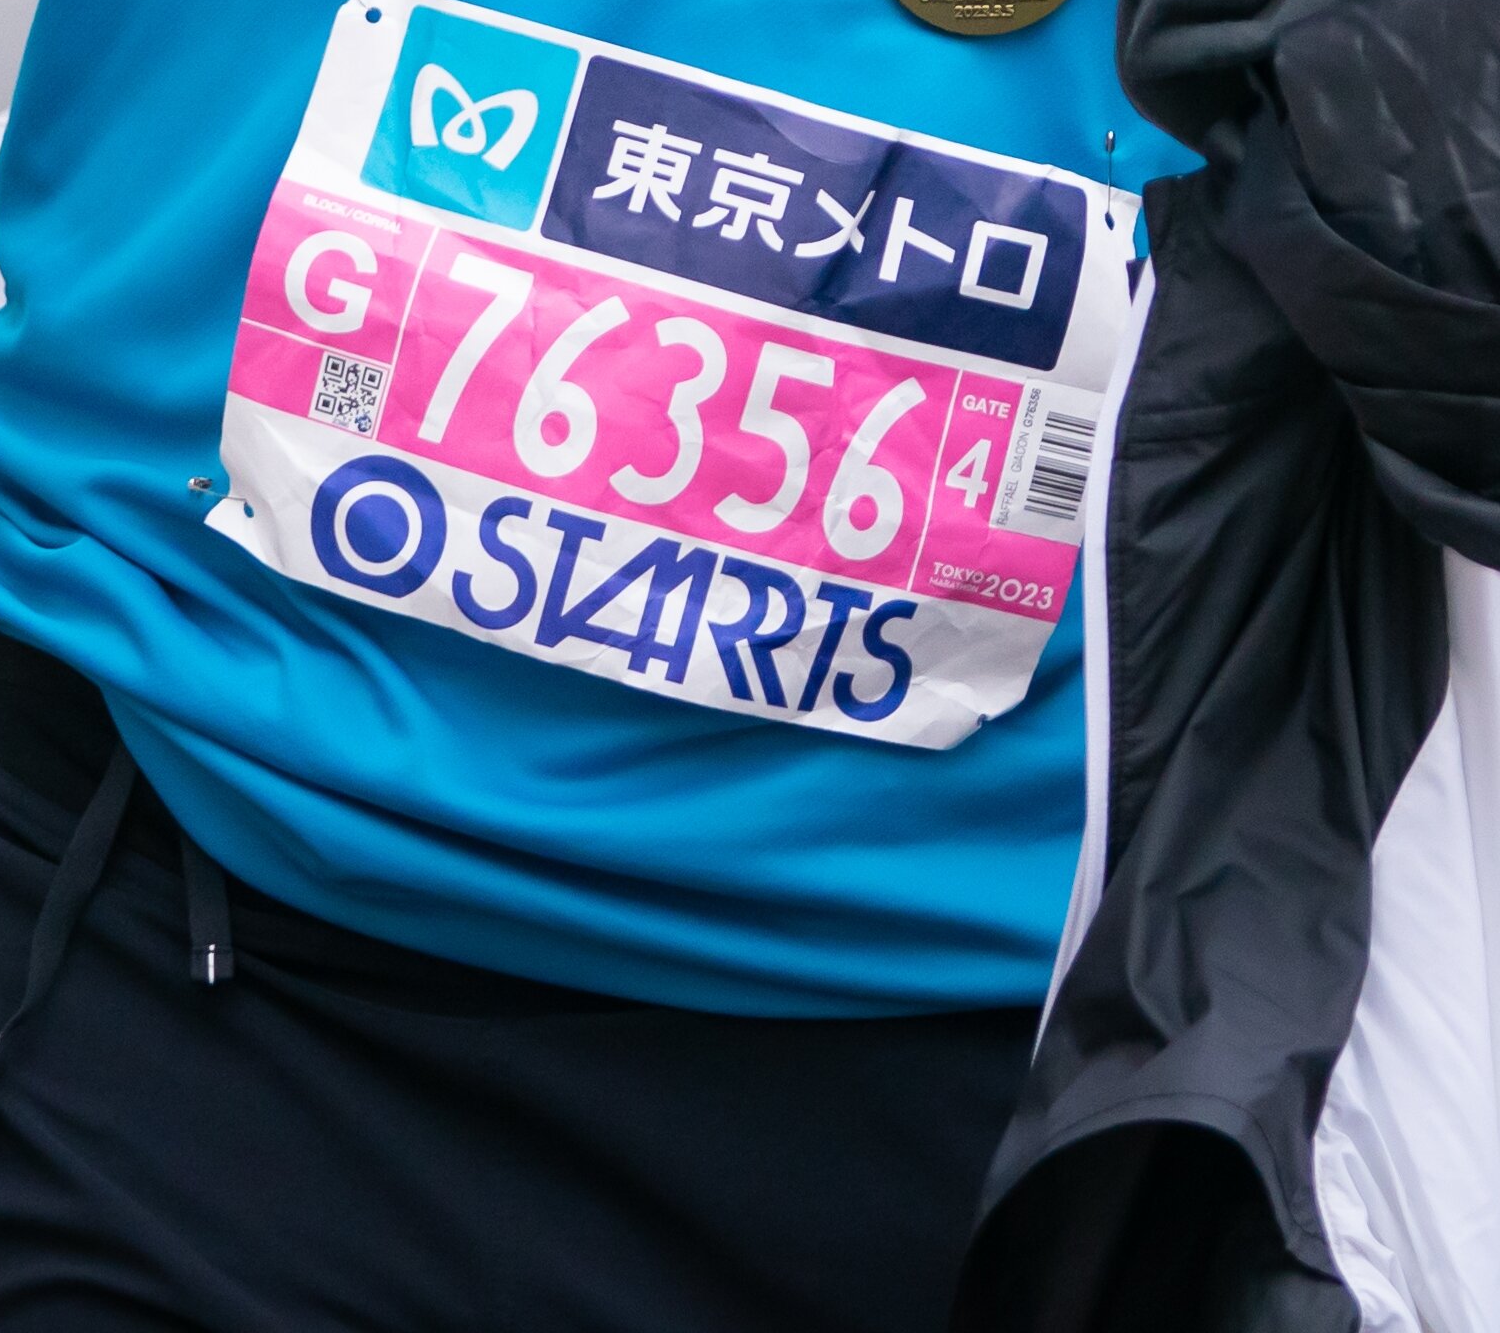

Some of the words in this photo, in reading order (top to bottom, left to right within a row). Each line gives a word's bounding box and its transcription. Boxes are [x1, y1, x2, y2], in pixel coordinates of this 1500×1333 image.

[303, 194, 403, 234] BLOCK/CORRAL
[593, 120, 1048, 310] 東京メトロ
[284, 230, 378, 334] G
[416, 255, 926, 563] 76356
[962, 394, 1012, 419] GATE
[1022, 388, 1042, 428] G76356
[945, 438, 992, 508] 4
[933, 562, 985, 583] TOKYO
[980, 573, 1054, 610] 2023
